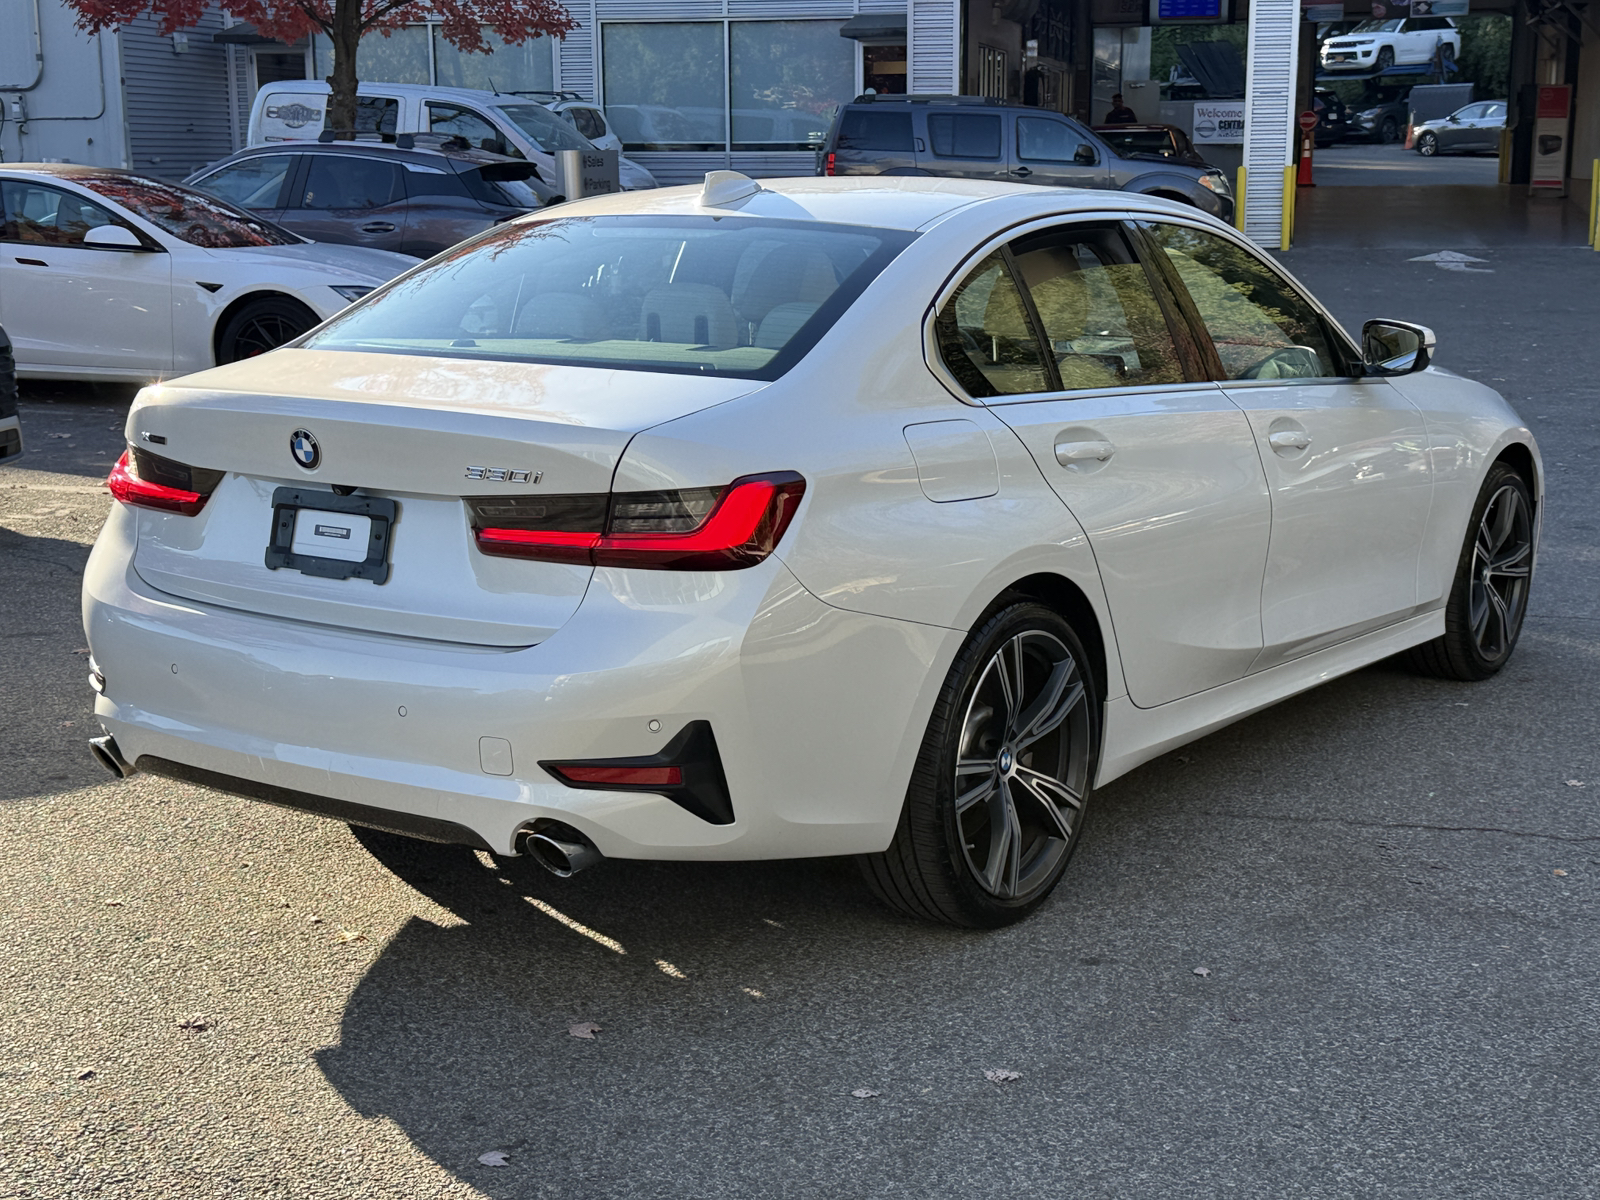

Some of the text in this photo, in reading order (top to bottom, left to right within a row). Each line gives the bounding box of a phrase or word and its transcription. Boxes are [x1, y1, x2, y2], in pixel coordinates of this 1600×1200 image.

[1197, 108, 1242, 118] Welcome
[587, 155, 604, 167] Sales
[589, 177, 611, 191] Parking
[464, 465, 544, 485] 330i
